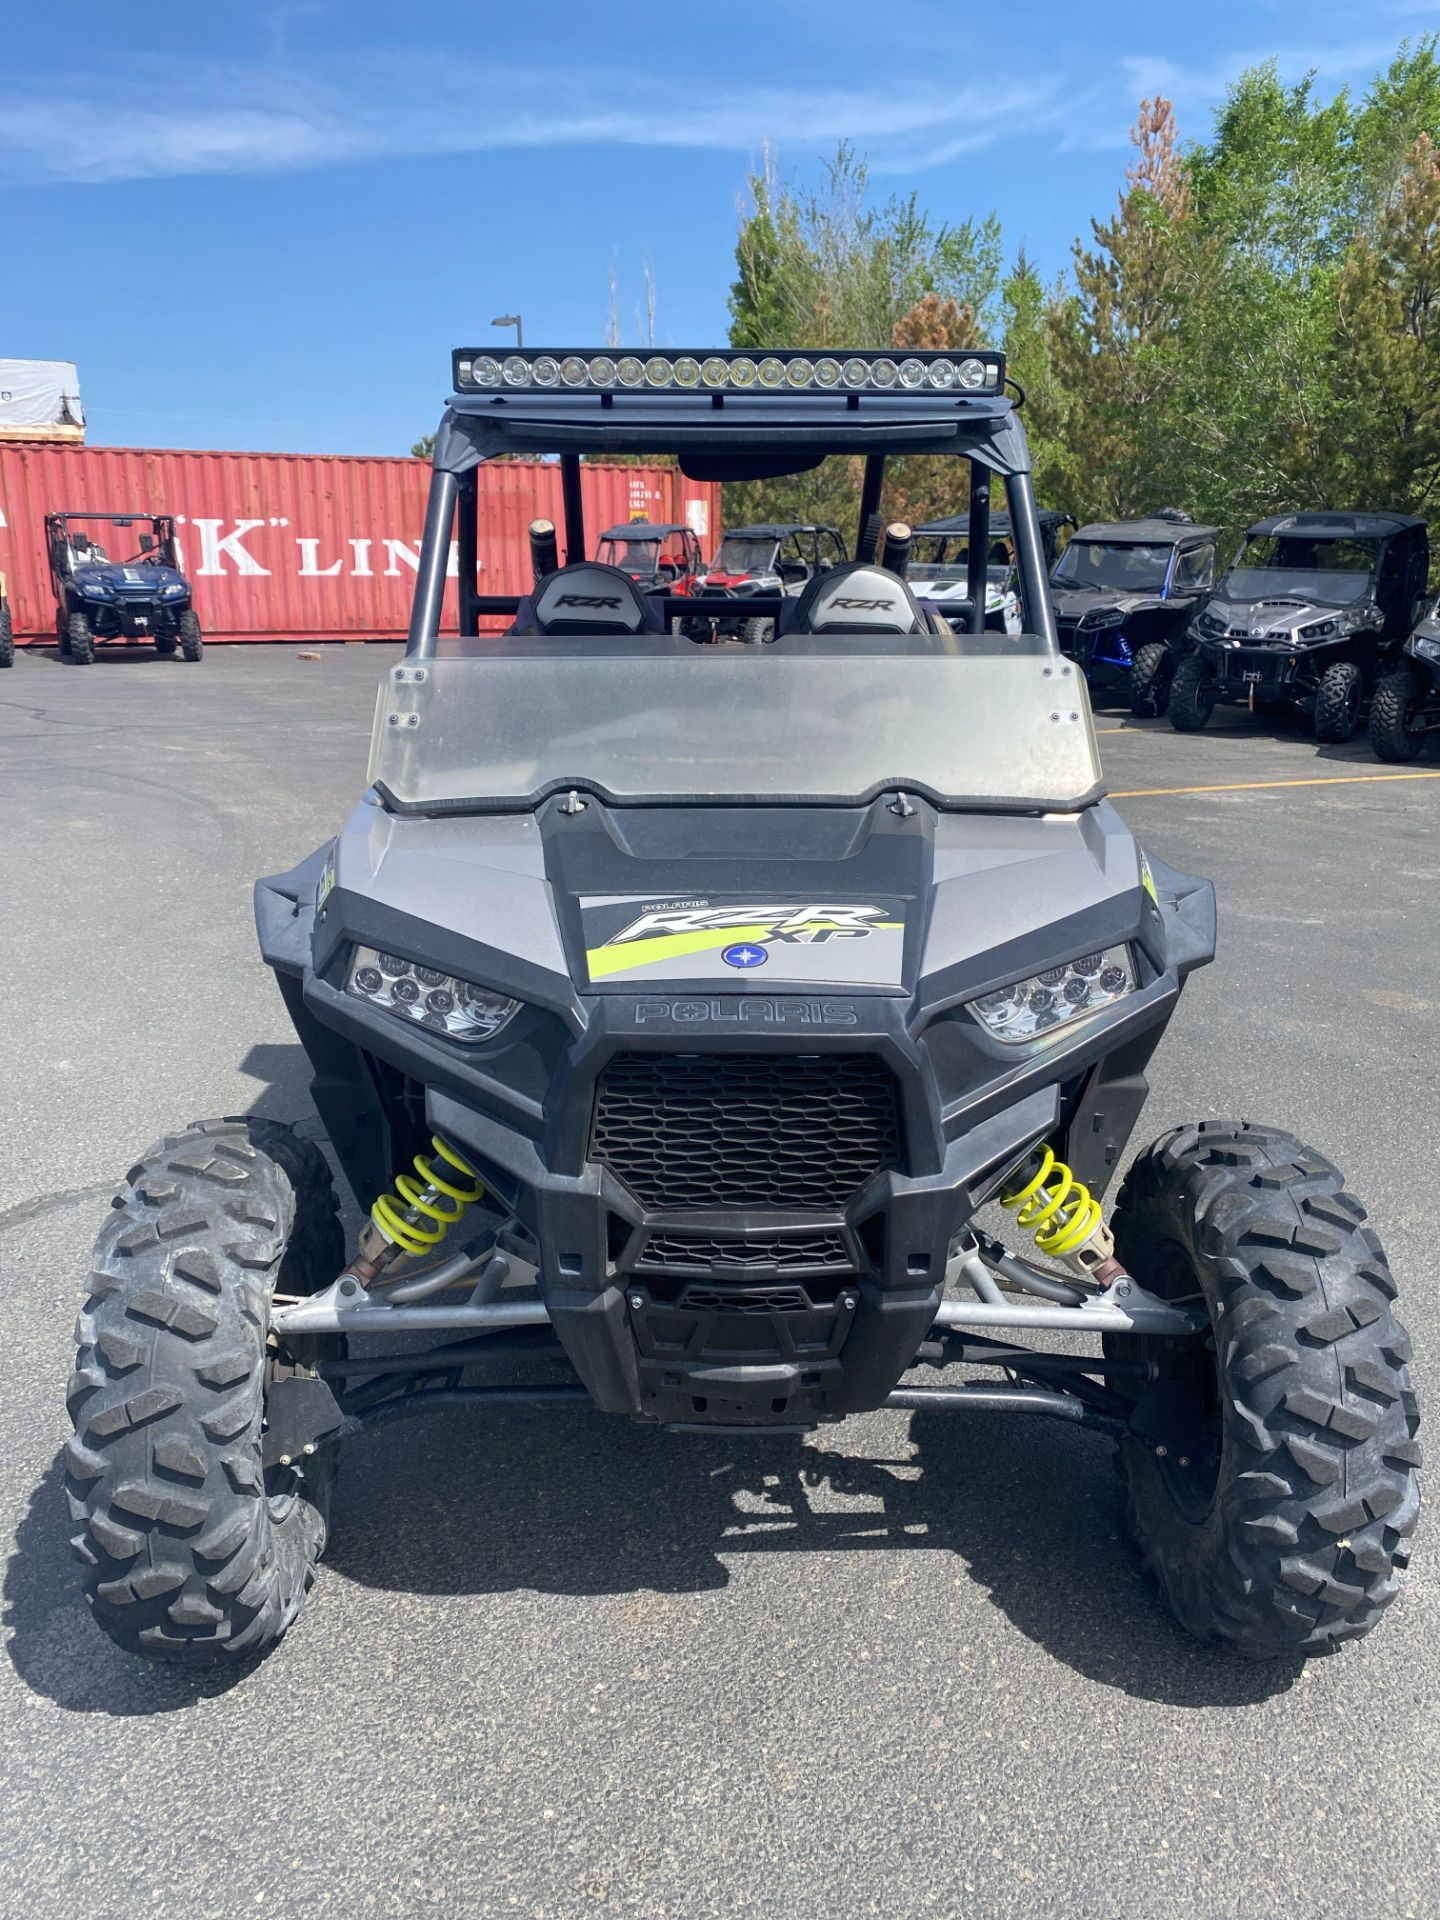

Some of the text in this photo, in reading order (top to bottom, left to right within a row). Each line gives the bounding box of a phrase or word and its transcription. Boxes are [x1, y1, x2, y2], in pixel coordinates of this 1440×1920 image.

[552, 593, 623, 610] RZR
[829, 597, 895, 612] RZR
[641, 900, 709, 912] POLARIS
[601, 904, 891, 948] RZR
[757, 927, 873, 946] XP
[634, 1001, 857, 1026] POLARIS
